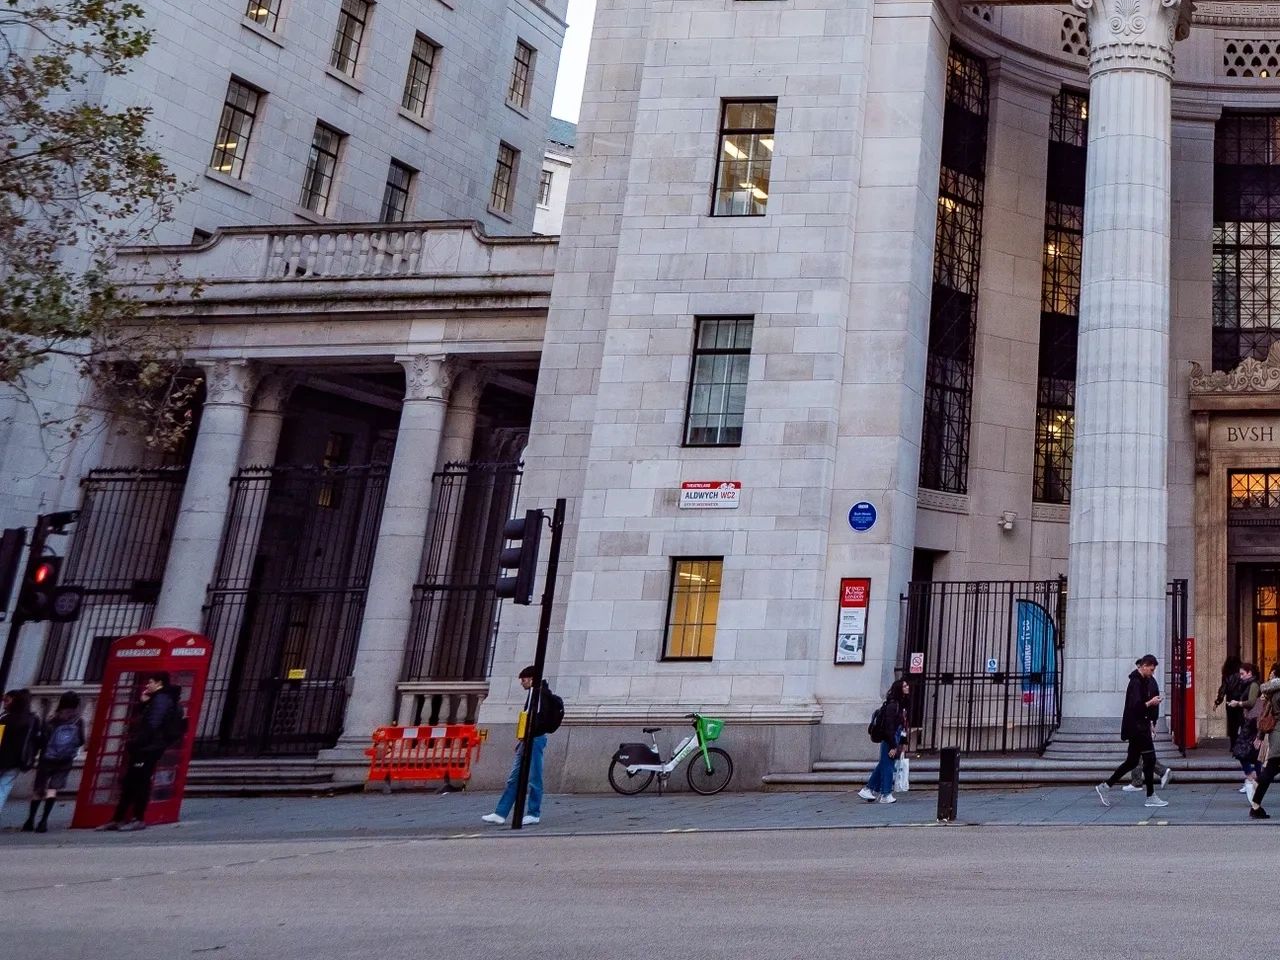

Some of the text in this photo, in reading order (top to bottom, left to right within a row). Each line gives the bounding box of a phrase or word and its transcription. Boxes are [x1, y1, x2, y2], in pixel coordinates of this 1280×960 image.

[1227, 426, 1273, 442] BVSH
[684, 491, 736, 499] ALDWYCH WC2
